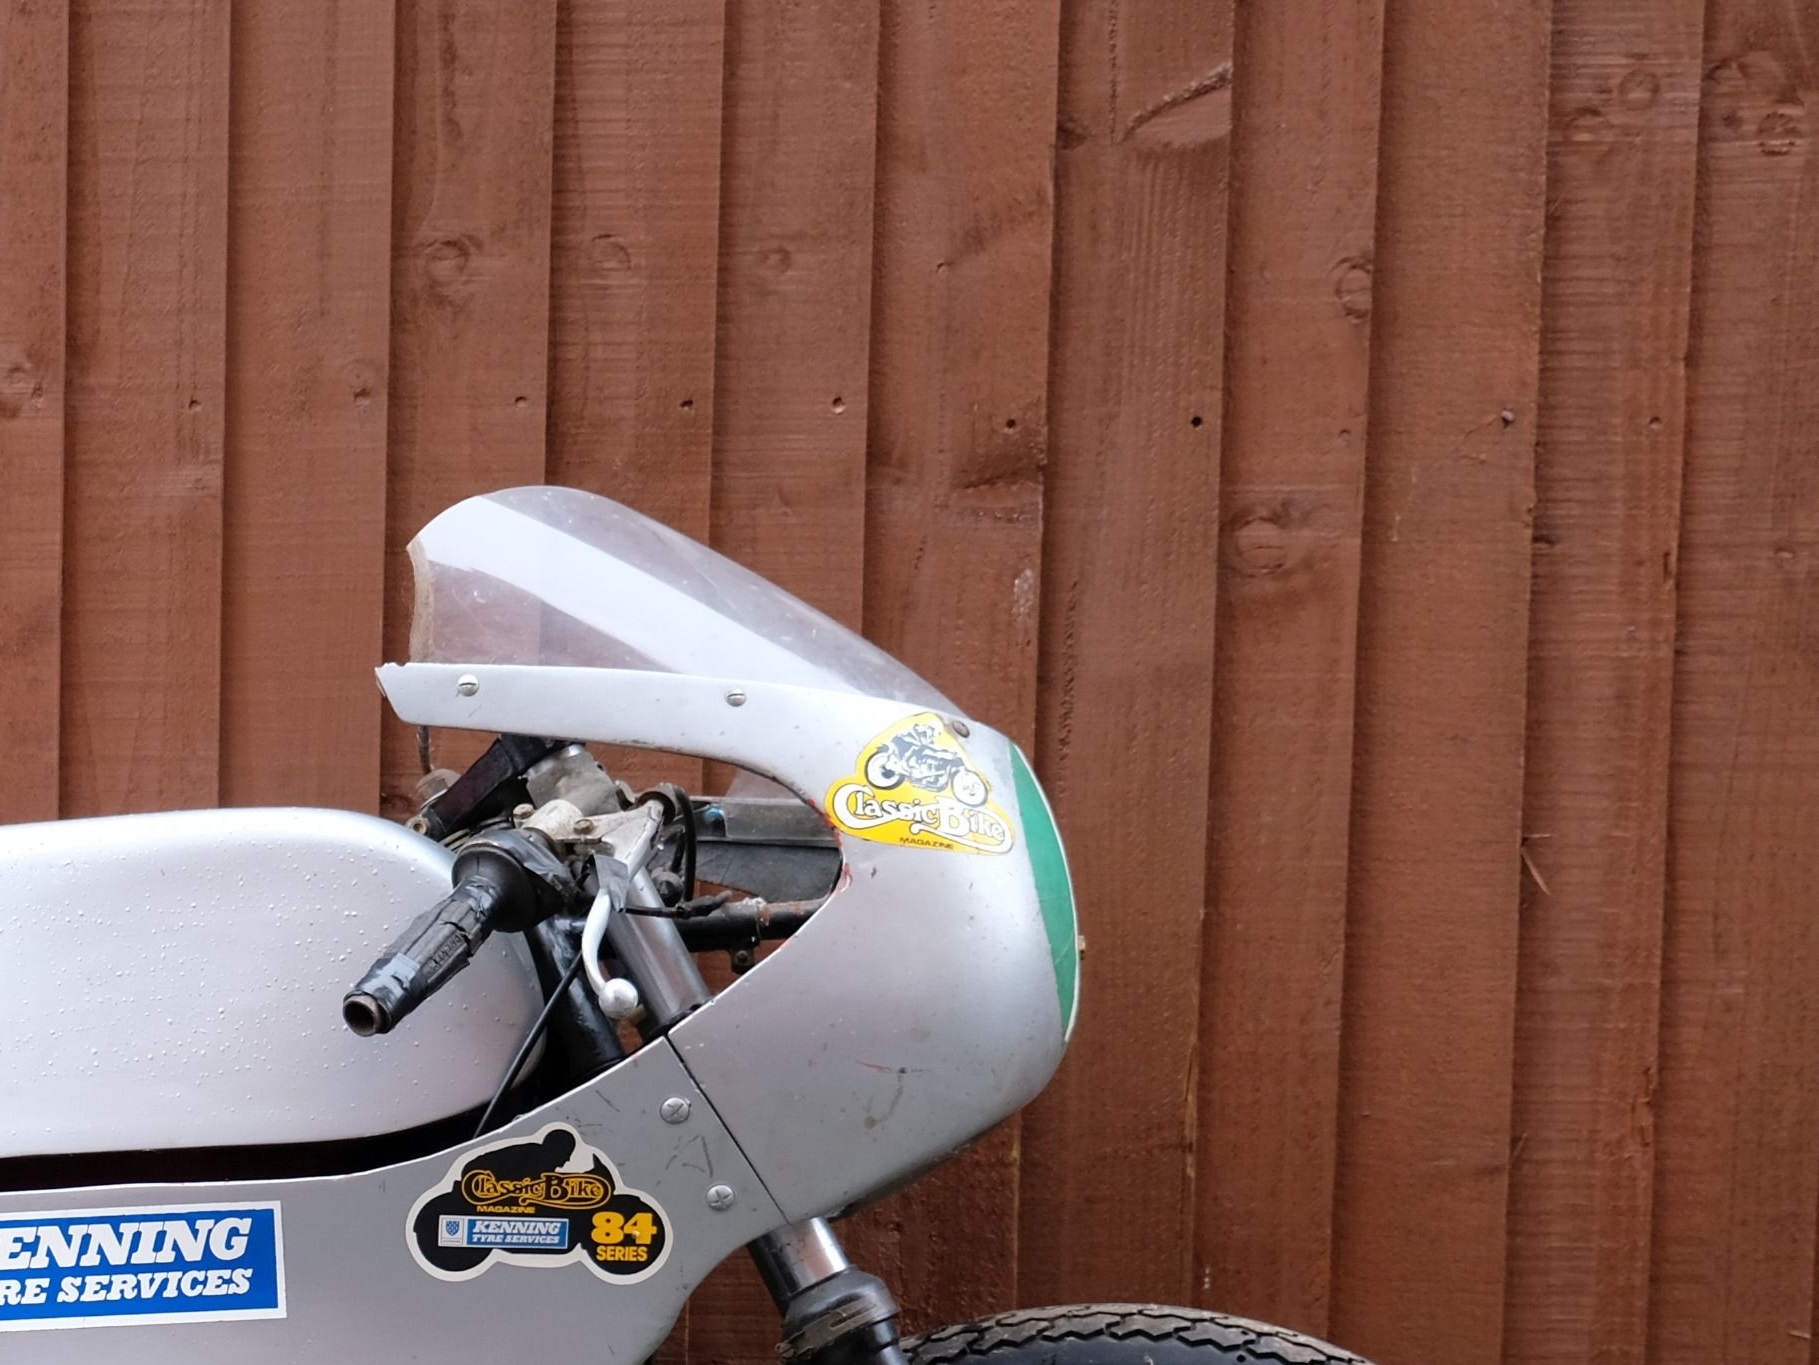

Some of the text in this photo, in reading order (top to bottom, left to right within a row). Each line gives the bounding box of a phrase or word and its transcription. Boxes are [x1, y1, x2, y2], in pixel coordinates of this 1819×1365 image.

[899, 836, 954, 851] MAGAZINE
[462, 1169, 546, 1205] Classic
[476, 1205, 535, 1214] MAGAZINE
[472, 1220, 561, 1234] KENNING
[591, 1211, 657, 1245] 84
[472, 1234, 502, 1244] TYRE
[506, 1234, 560, 1244] SERVICES
[596, 1246, 648, 1261] SERIES
[56, 1268, 253, 1303] SERVICES
